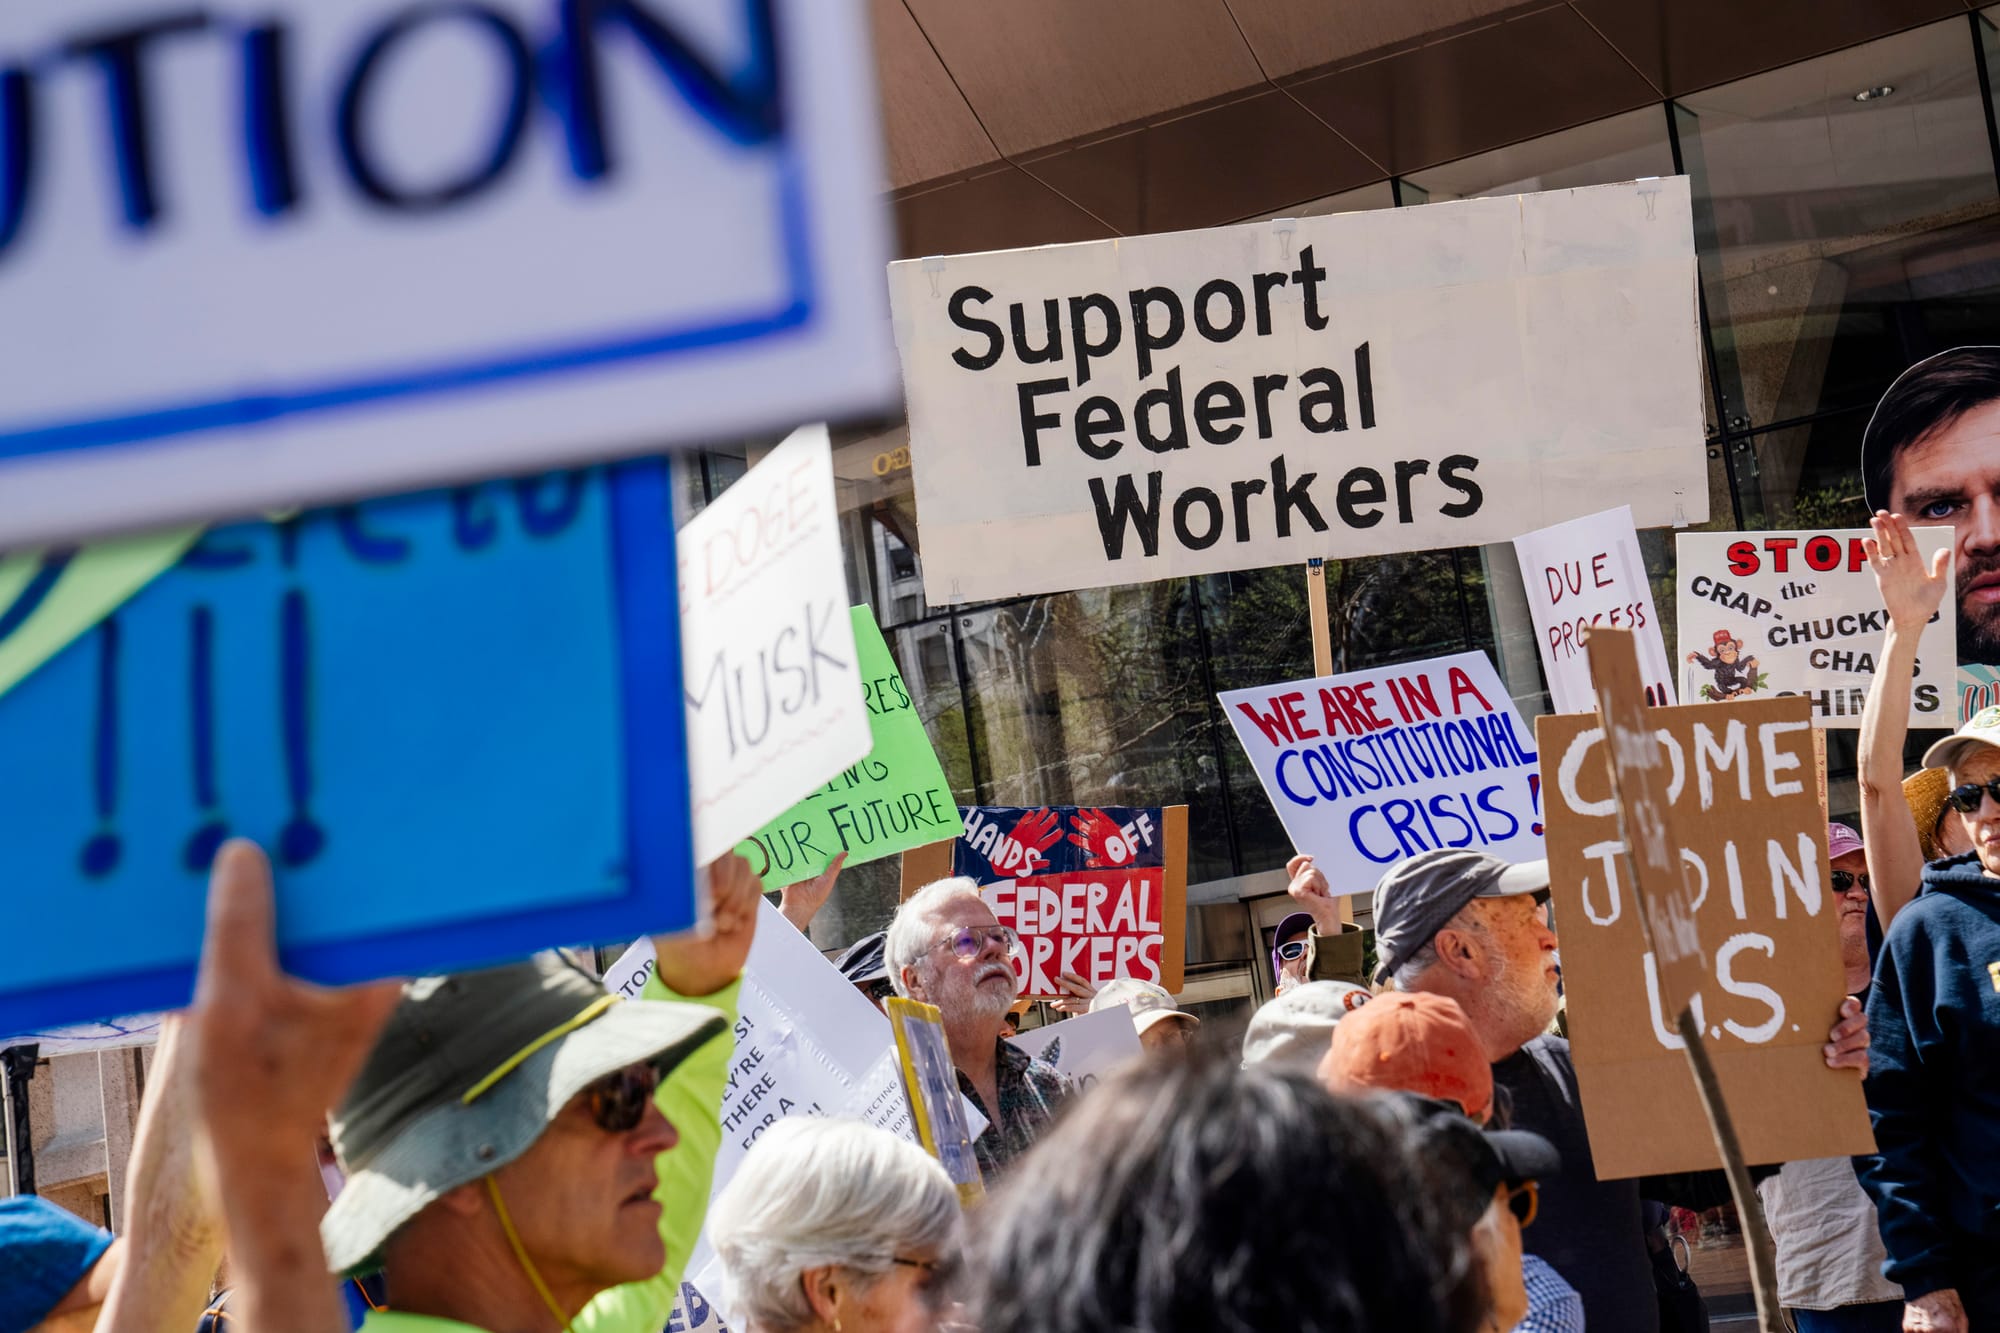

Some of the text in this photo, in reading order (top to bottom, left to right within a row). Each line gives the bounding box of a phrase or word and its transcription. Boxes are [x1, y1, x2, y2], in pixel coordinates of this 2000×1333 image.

[947, 244, 1330, 386] Support
[1016, 340, 1376, 467] Federal
[704, 457, 818, 597] DOGE
[1087, 453, 1485, 561] Workers
[1545, 552, 1614, 606] DUE
[1691, 576, 1783, 620] CRAP-
[1780, 581, 1817, 600] the
[684, 599, 848, 760] MUSK
[1809, 649, 1921, 678] CHA
[1236, 667, 1493, 747] WE ARE IN A
[1275, 711, 1538, 807] CONSTITUTIONAL
[827, 789, 950, 852] FUTURE
[960, 807, 1154, 878] HANDS OFF
[979, 879, 1160, 935] FEDERAL
[616, 959, 655, 1000] TOP
[1009, 934, 1163, 995] ORKERS
[721, 1046, 765, 1105] EY'RE
[721, 1072, 776, 1132] THERE
[863, 1080, 897, 1119] TECTING
[779, 1097, 795, 1115] A
